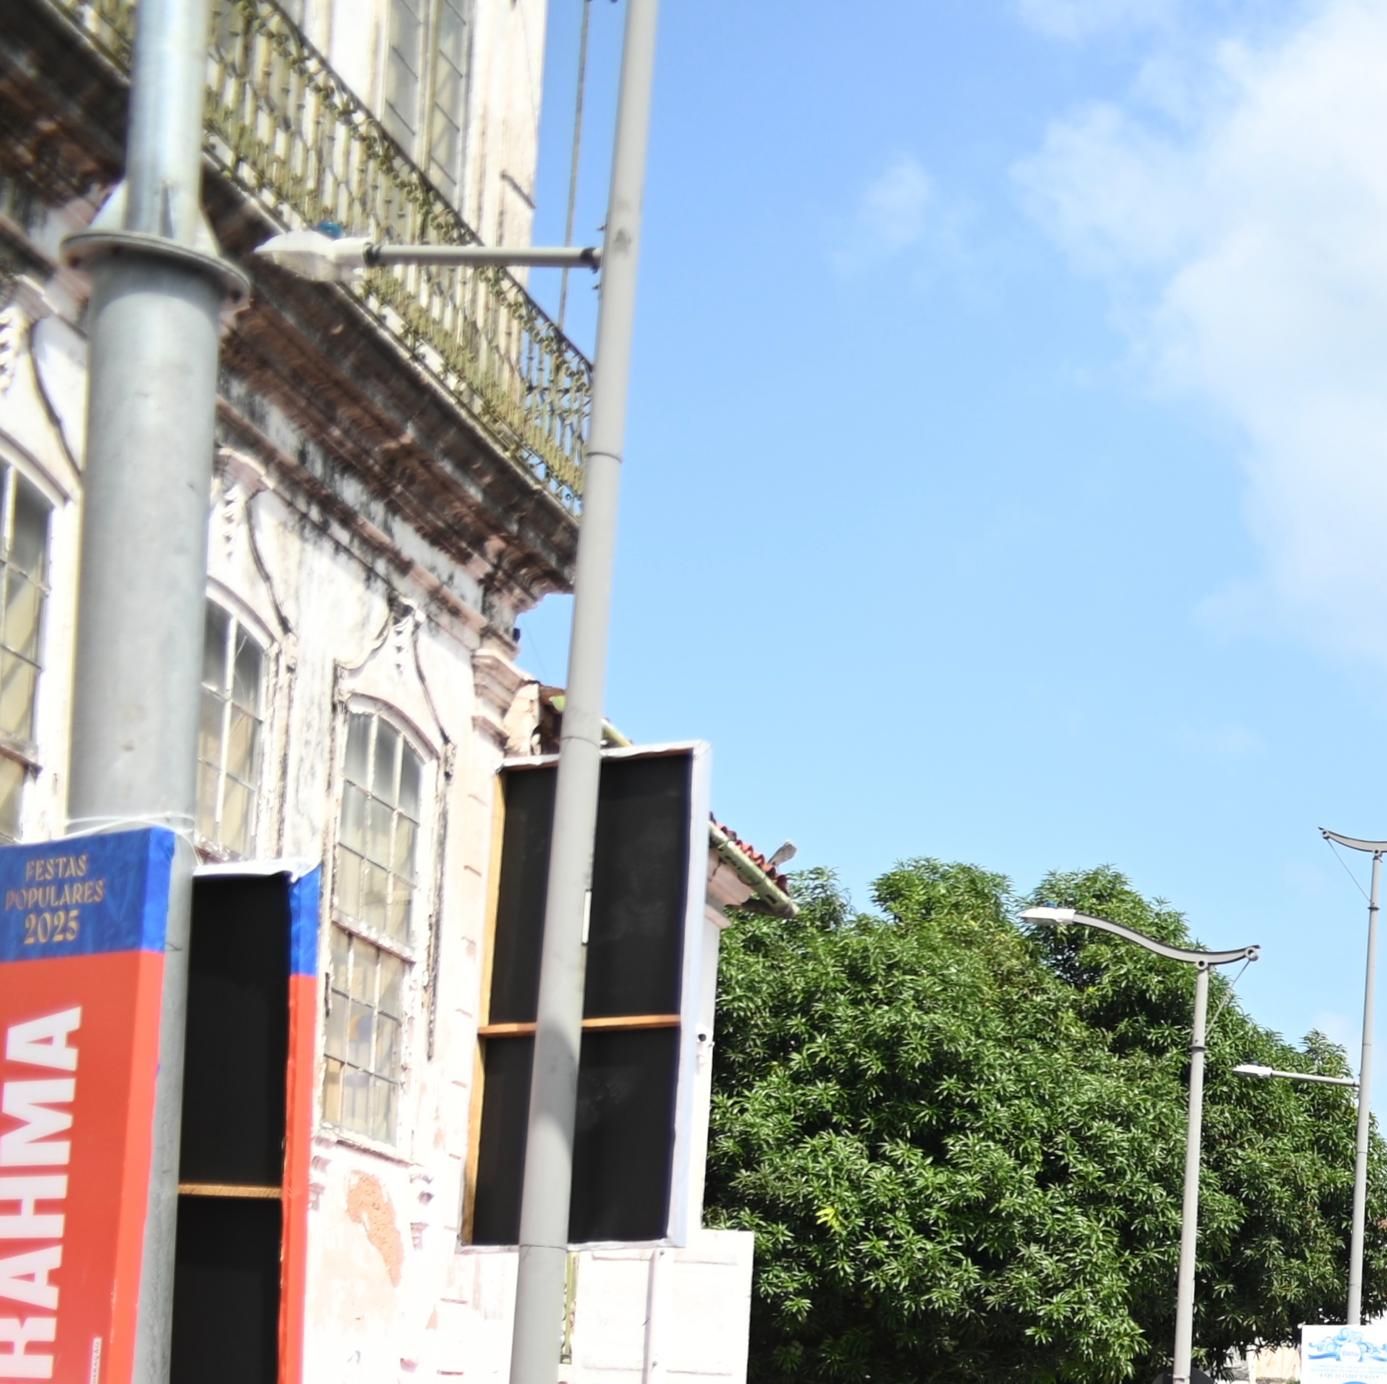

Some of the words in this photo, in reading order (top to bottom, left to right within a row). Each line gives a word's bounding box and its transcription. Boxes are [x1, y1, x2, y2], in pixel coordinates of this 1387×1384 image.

[25, 853, 89, 881] FESTAS
[5, 878, 106, 910] POPULARES
[24, 909, 80, 944] 2025
